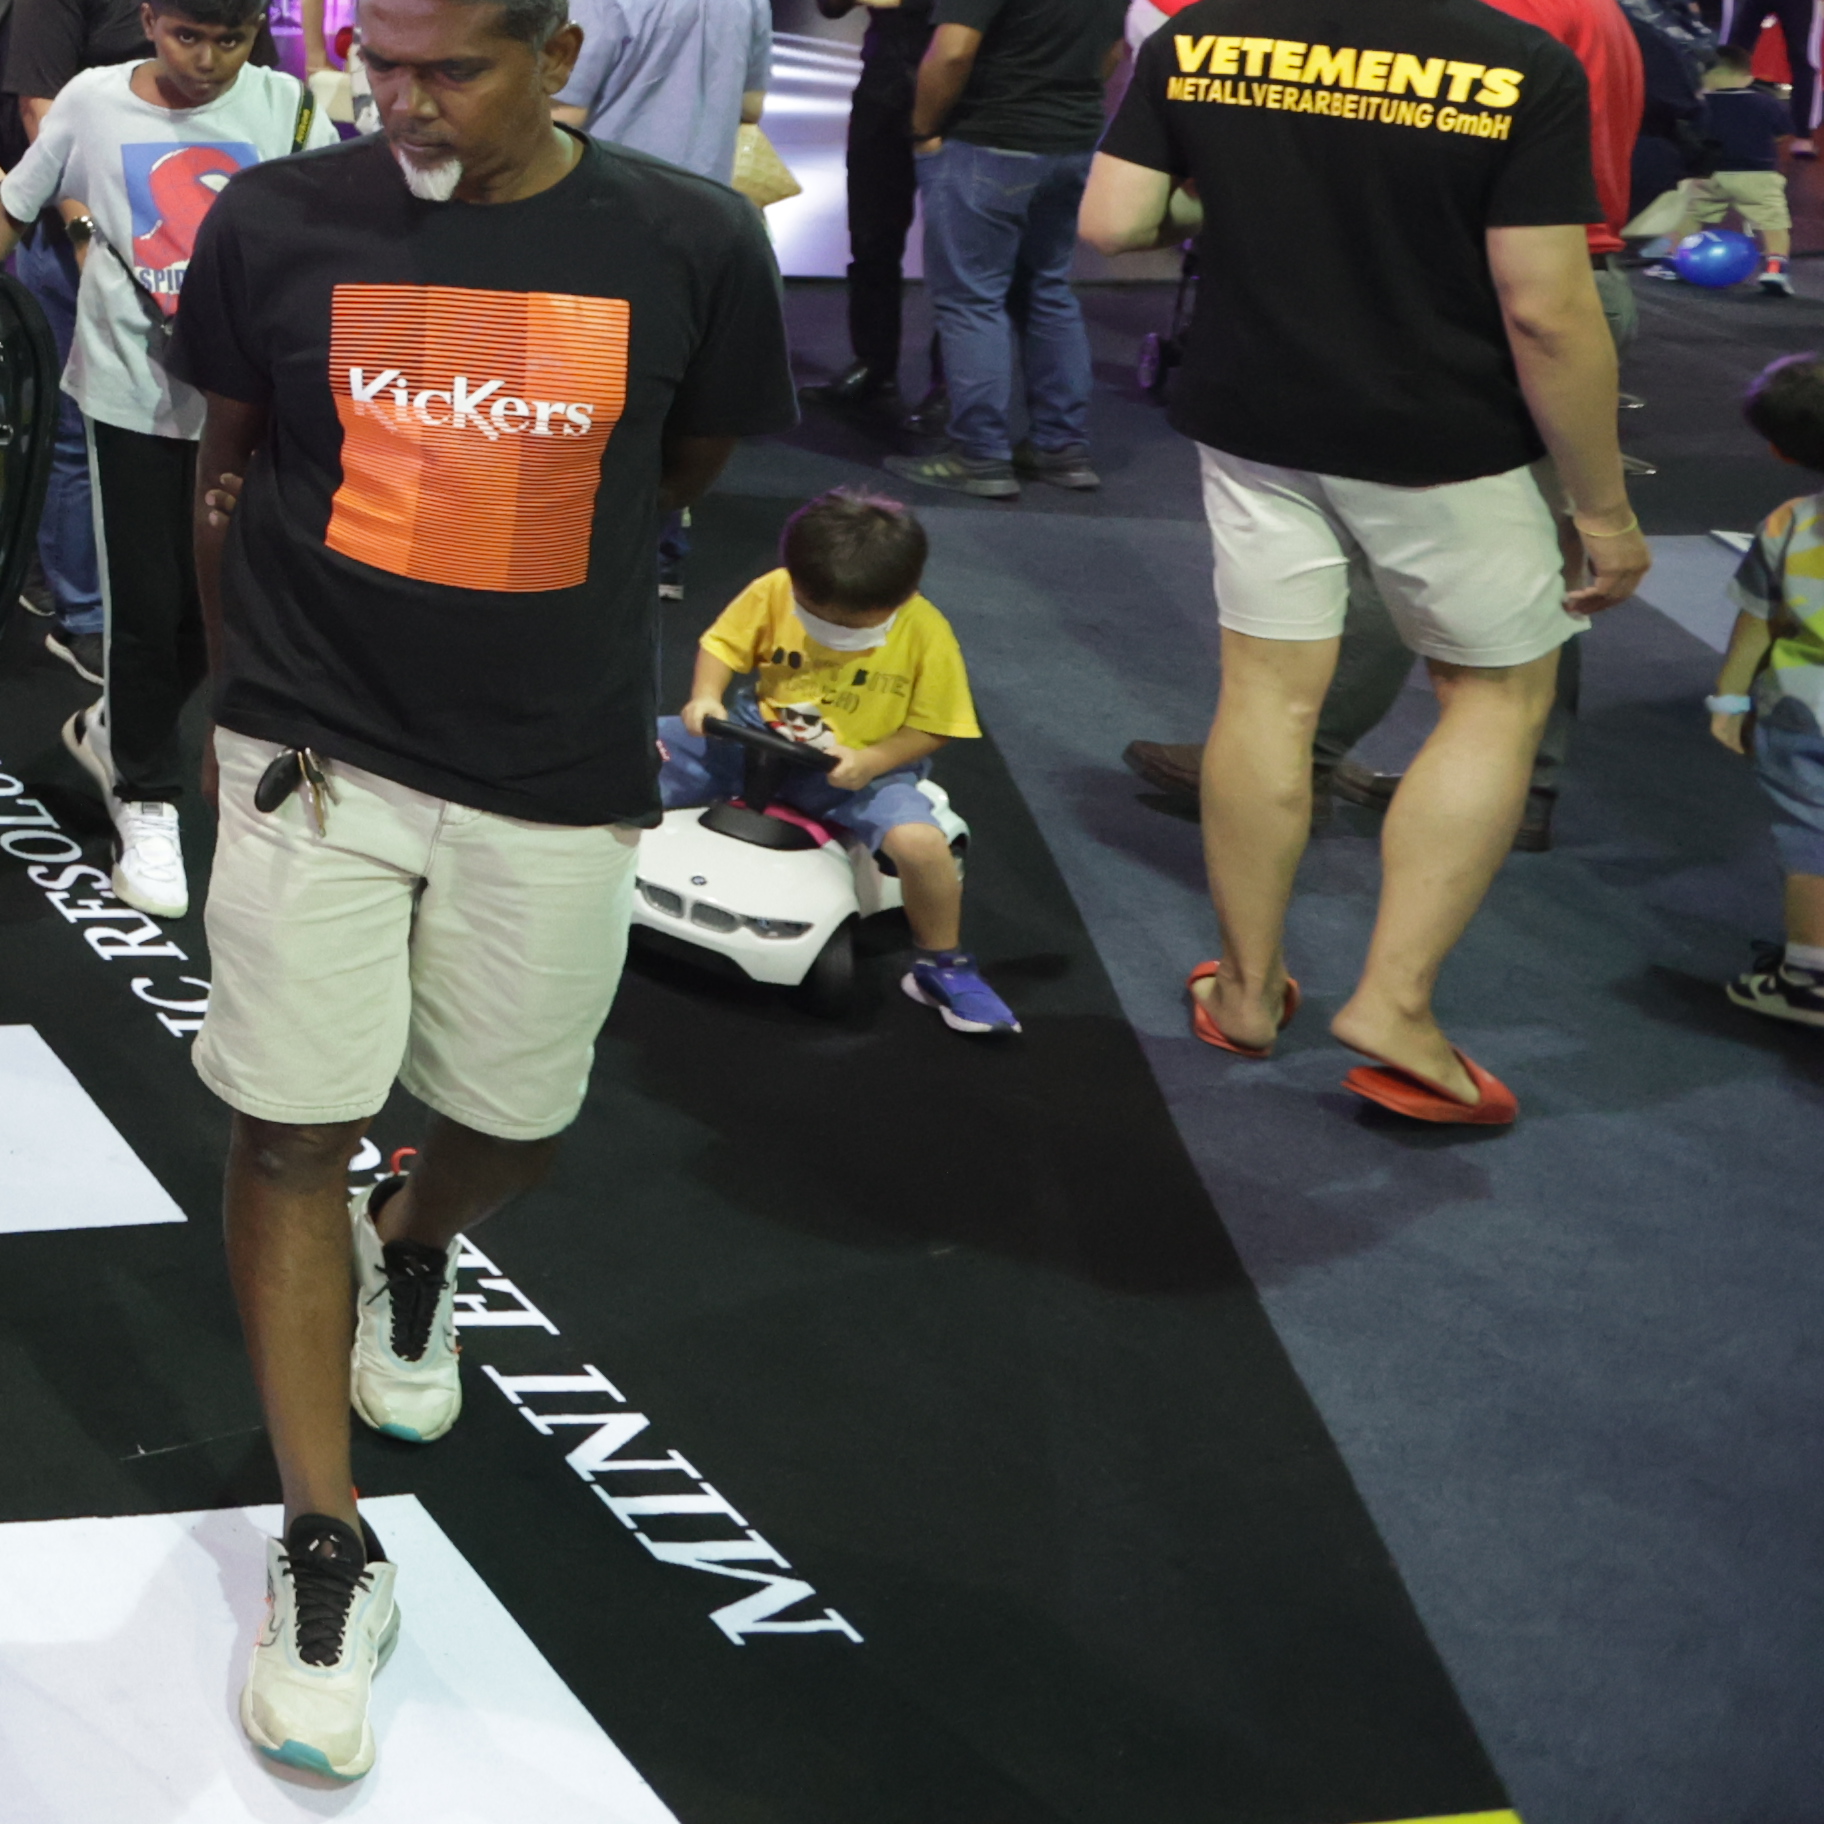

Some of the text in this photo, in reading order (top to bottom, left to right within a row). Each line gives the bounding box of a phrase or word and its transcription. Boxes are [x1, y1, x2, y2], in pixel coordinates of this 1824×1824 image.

[1166, 76, 1513, 141] METALLVERARBEITUNG GmbH
[1174, 34, 1525, 109] VETEMENTS
[481, 1363, 865, 1647] MINI
